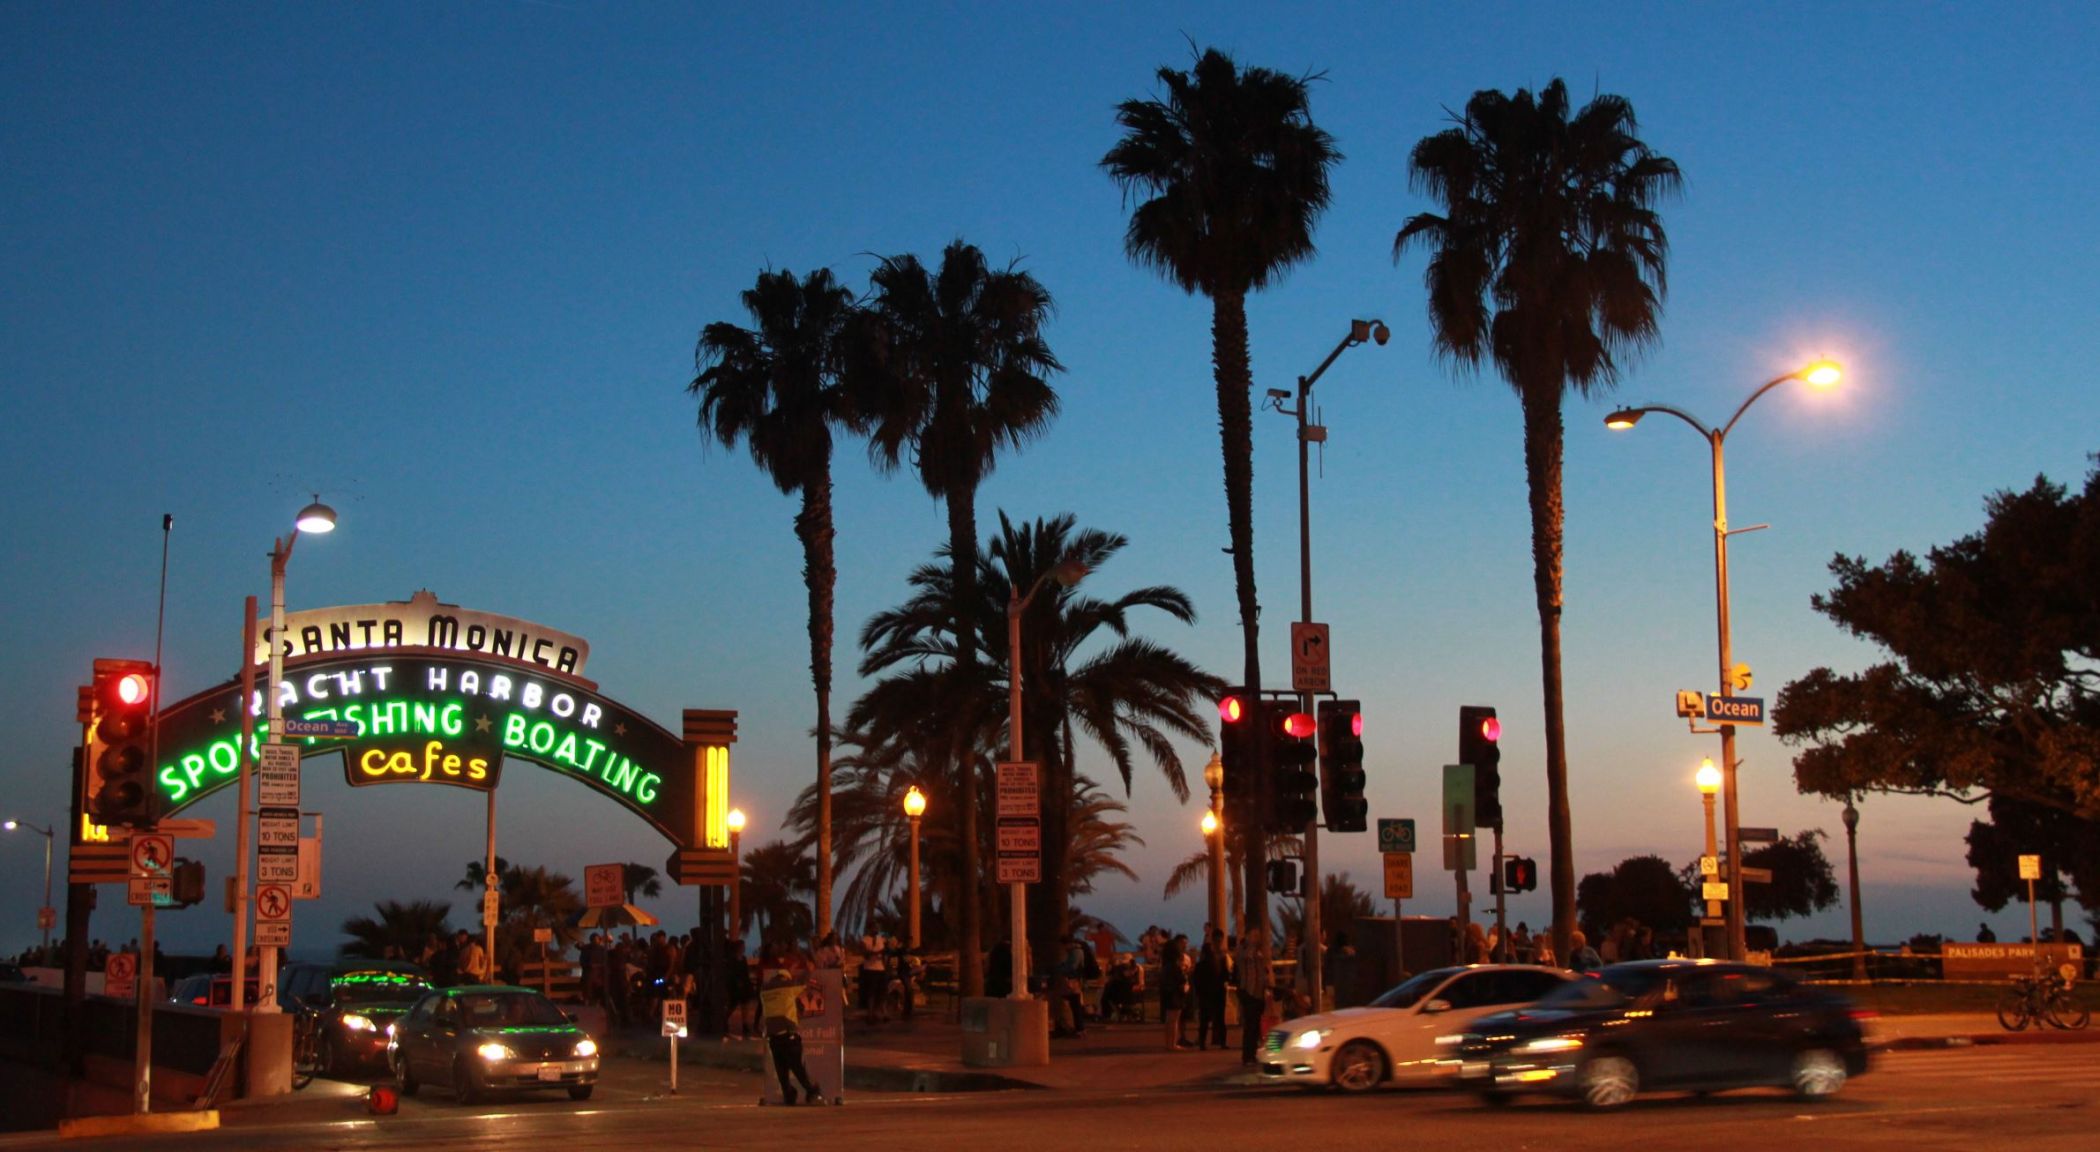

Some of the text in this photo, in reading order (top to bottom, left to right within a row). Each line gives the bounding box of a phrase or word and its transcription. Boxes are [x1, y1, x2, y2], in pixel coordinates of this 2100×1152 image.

[263, 613, 578, 674] SANTA MONICA
[1311, 667, 1328, 676] RED
[1297, 677, 1327, 686] ARROW
[428, 666, 602, 728] HARBOR
[1711, 698, 1759, 717] Ocean
[286, 720, 328, 732] Ocean
[361, 740, 488, 782] cafes
[504, 713, 661, 803] BOATING
[262, 772, 297, 781] PROHIBITED
[262, 832, 296, 841] 10 TONS
[1001, 838, 1036, 847] 10 TONS
[262, 867, 294, 877] 3 TONS
[1002, 868, 1035, 878] 3 TONS
[1949, 947, 2035, 959] PALISADES PARK
[668, 1003, 682, 1016] NO
